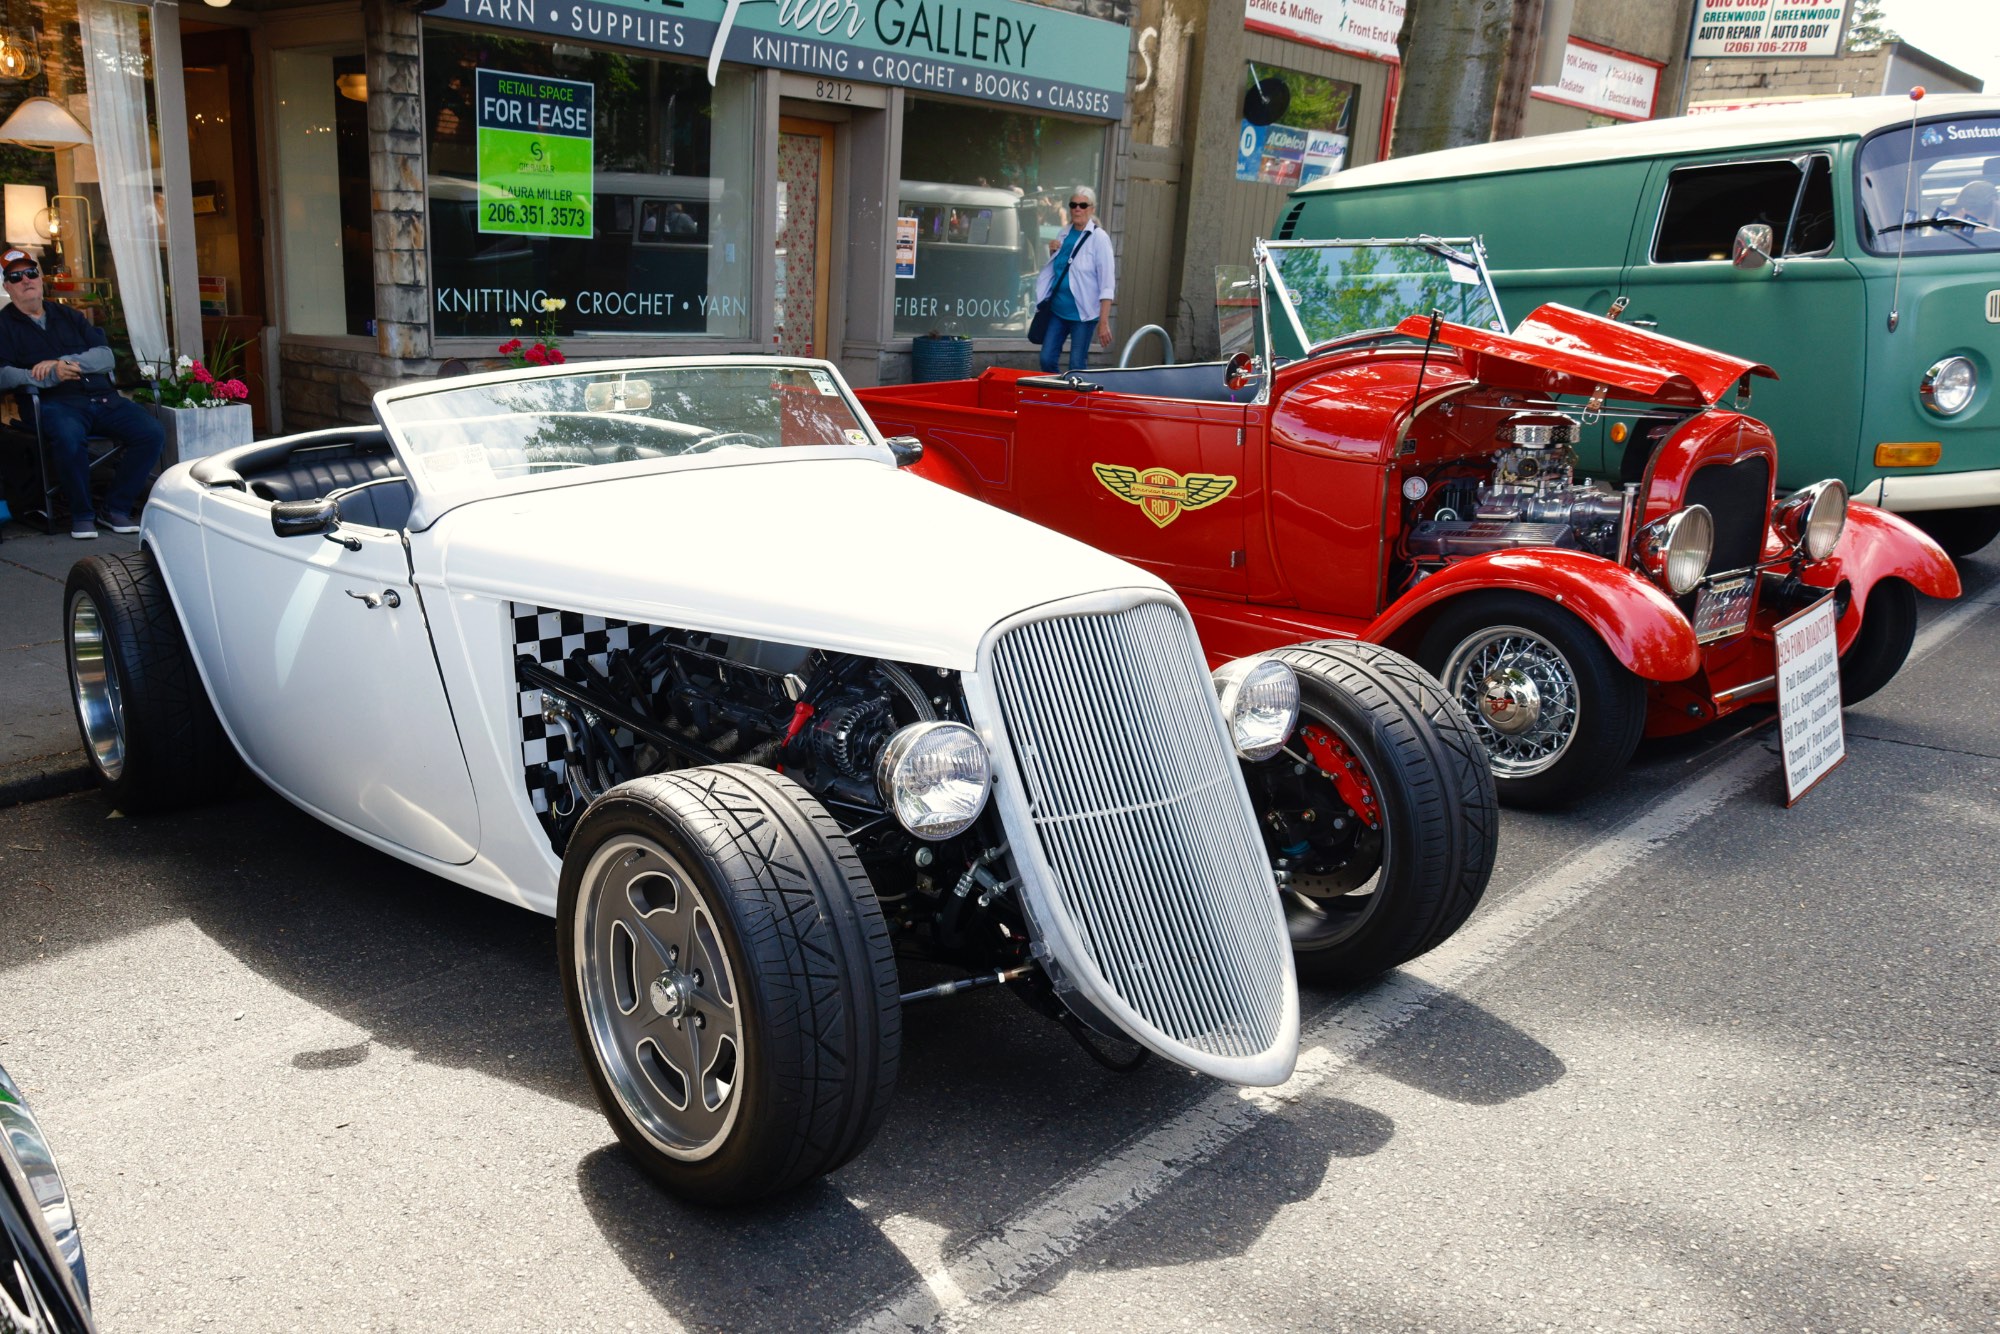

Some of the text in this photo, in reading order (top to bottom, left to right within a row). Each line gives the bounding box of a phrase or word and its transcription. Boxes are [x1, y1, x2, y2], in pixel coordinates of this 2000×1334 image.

[1249, 0, 1323, 25] Brake & Muffler
[1703, 10, 1766, 23] GREENWOOD
[1774, 8, 1840, 20] GREENWOOD
[463, 0, 684, 47] YARN SUPPLIES
[1348, 20, 1372, 38] Front
[1372, 26, 1389, 42] End
[1698, 25, 1762, 40] AUTO REPAIR
[1770, 24, 1830, 39] AUTO BODY
[874, 0, 1037, 68] GALLERY
[1724, 41, 1808, 53] (206) 706-2778
[1578, 55, 1598, 73] Service
[753, 36, 1110, 114] KNITTING CROCHET BOOKS CLASSES
[498, 79, 574, 102] RETAIL SPACE
[816, 81, 853, 102] 8212
[484, 97, 587, 131] FOR LEASE
[1266, 131, 1306, 150] ACDelco
[501, 184, 573, 202] LAURA MILLER
[488, 203, 585, 228] 206.351.3573
[576, 291, 674, 316] CROCHET
[698, 295, 746, 316] YARN
[894, 297, 938, 316] FIBER
[956, 299, 1010, 318] BOOKS
[1151, 475, 1169, 486] HOT
[1131, 486, 1186, 499] American Racing
[1151, 499, 1170, 517] ROD
